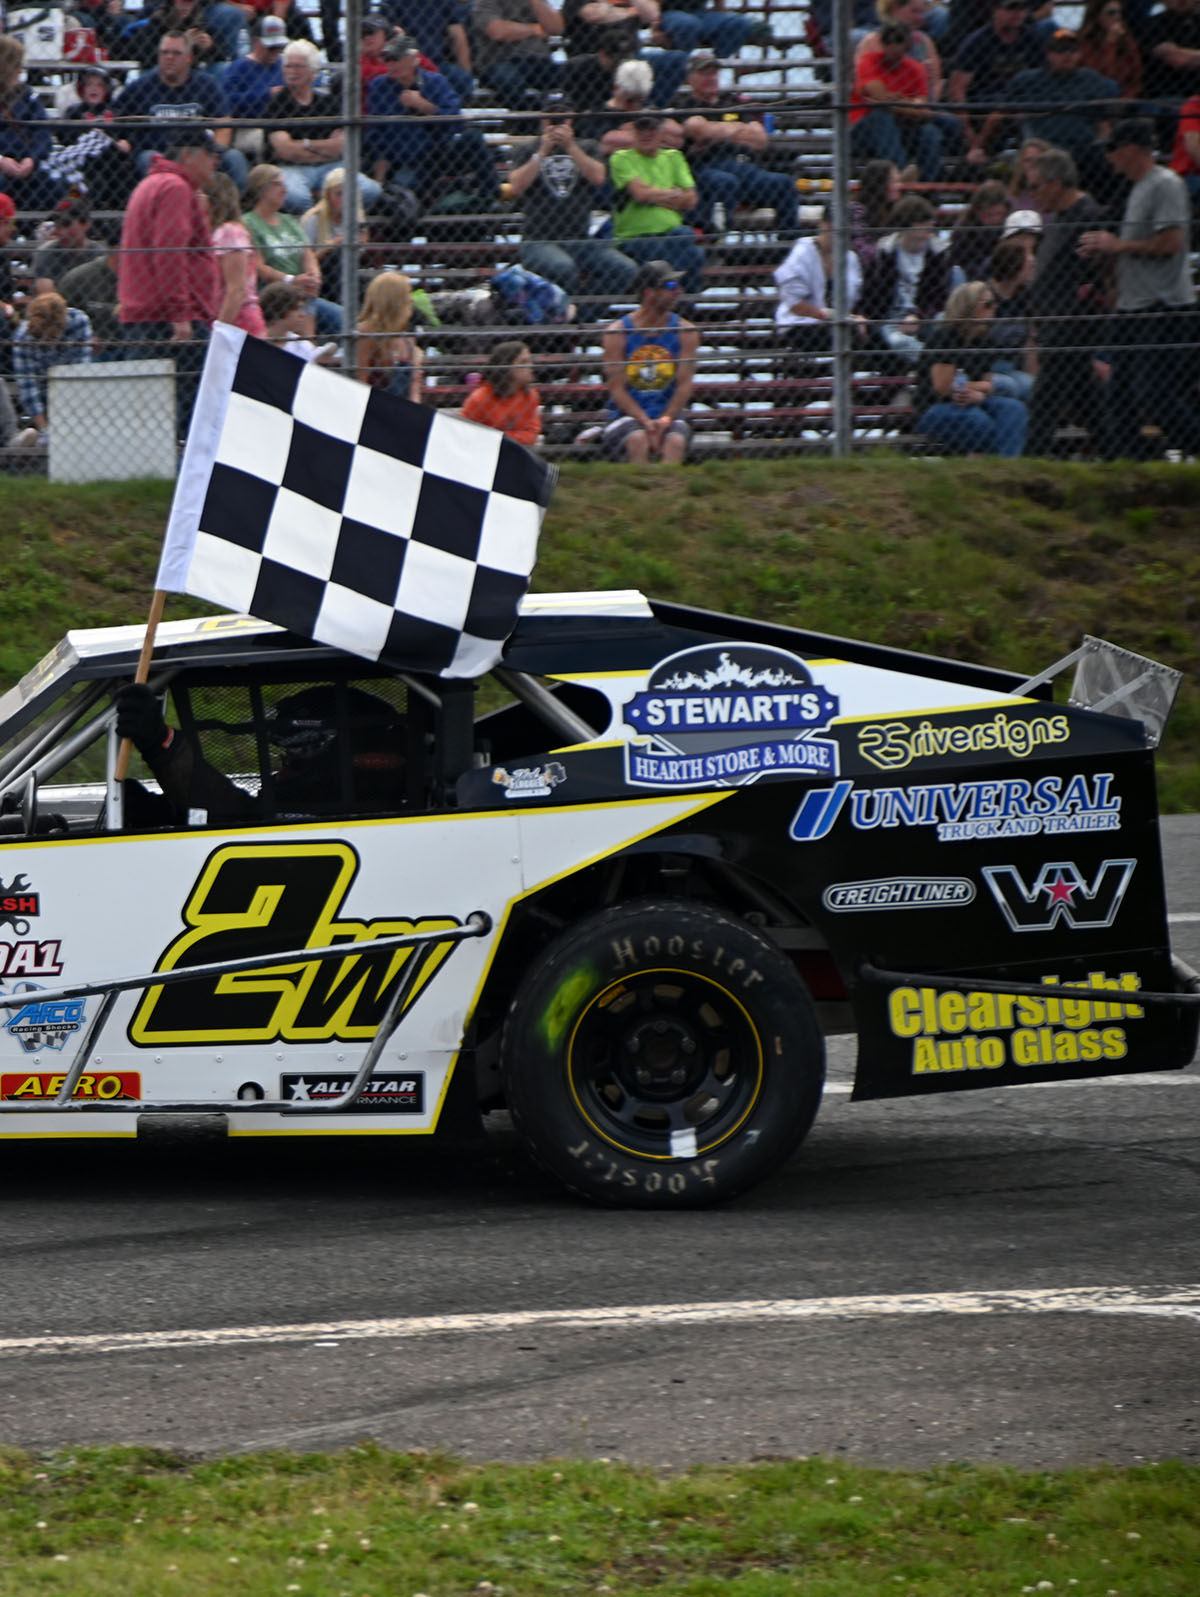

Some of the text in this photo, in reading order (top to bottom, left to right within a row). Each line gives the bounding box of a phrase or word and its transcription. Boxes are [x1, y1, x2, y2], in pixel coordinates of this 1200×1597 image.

[646, 692, 821, 726] STEWART'S
[636, 744, 831, 781] HEARTH STORE & MORE
[850, 773, 1121, 829] UNIVERSAL
[936, 812, 1121, 841] TRUCK AND TRAILER
[834, 884, 967, 905] FREIGHTLINER
[888, 971, 1145, 1037] Clearsight
[912, 1026, 1128, 1074] Auto Glass
